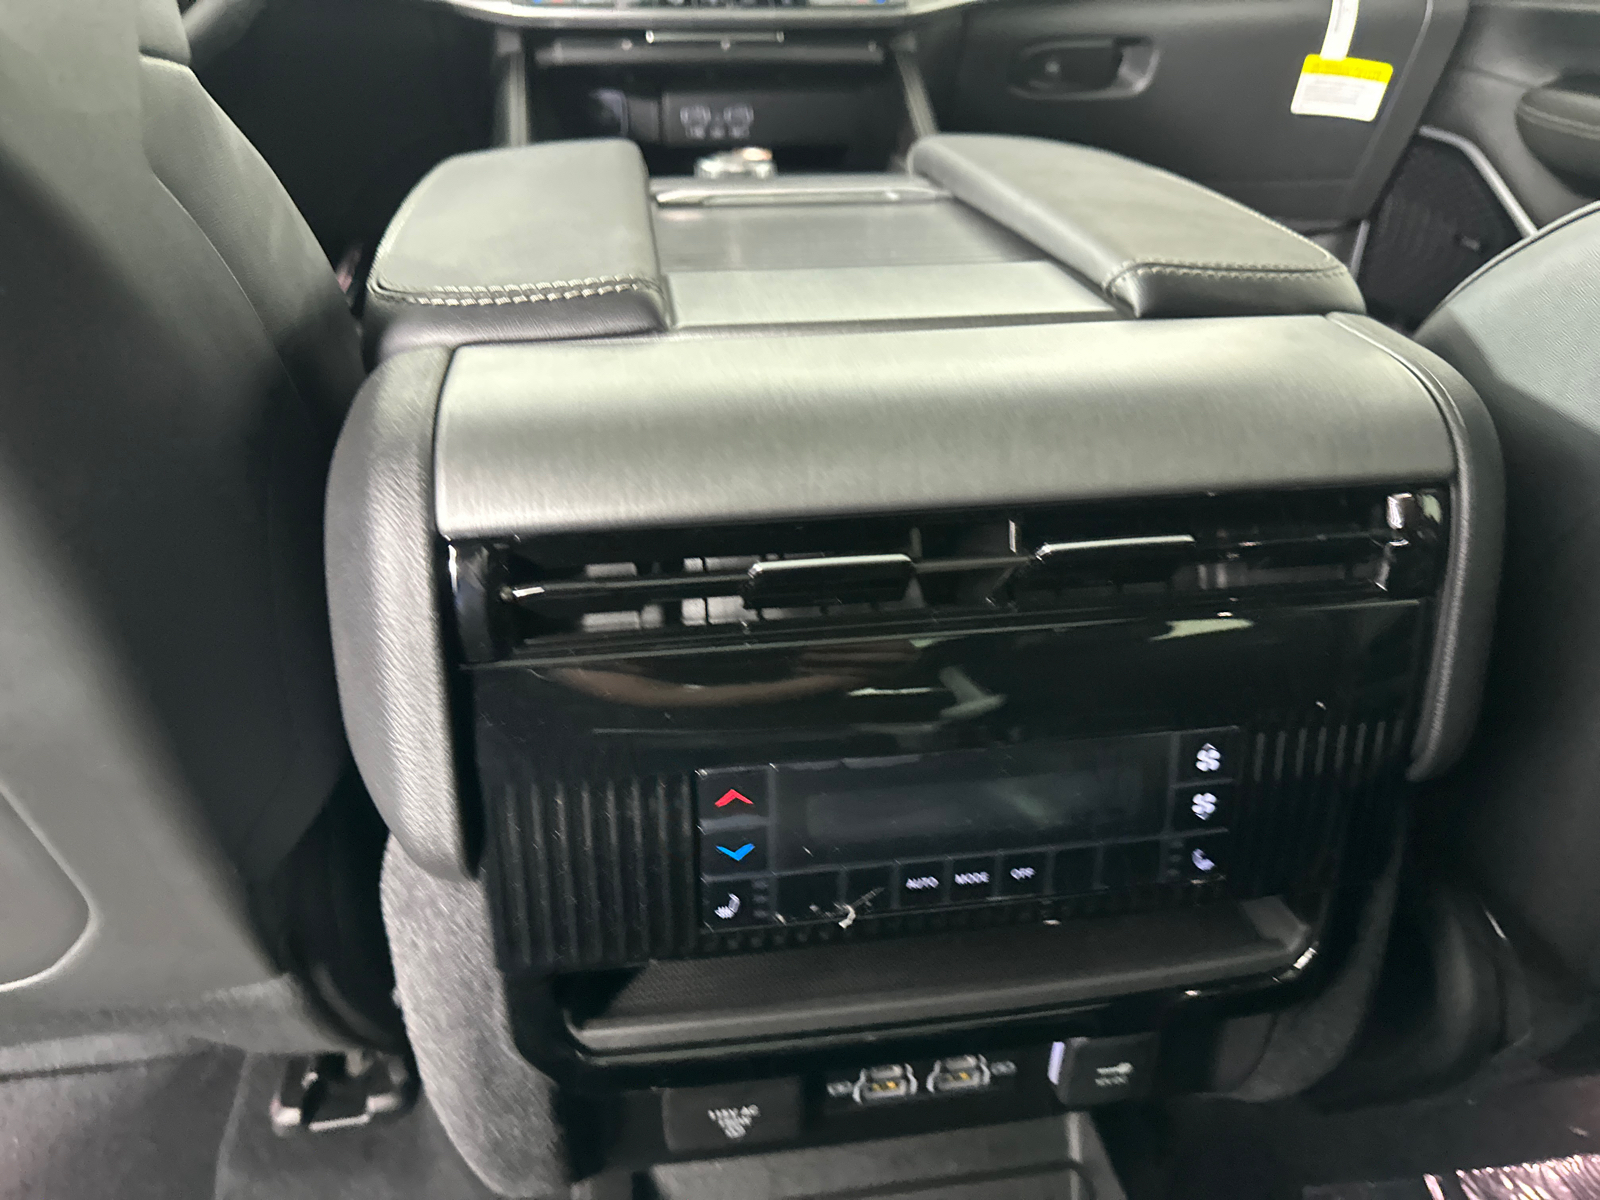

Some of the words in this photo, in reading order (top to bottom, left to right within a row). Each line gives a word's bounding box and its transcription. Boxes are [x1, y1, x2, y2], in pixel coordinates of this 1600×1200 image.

[954, 871, 990, 886] MODE
[1010, 867, 1036, 881] OFF
[905, 876, 940, 890] AUTO
